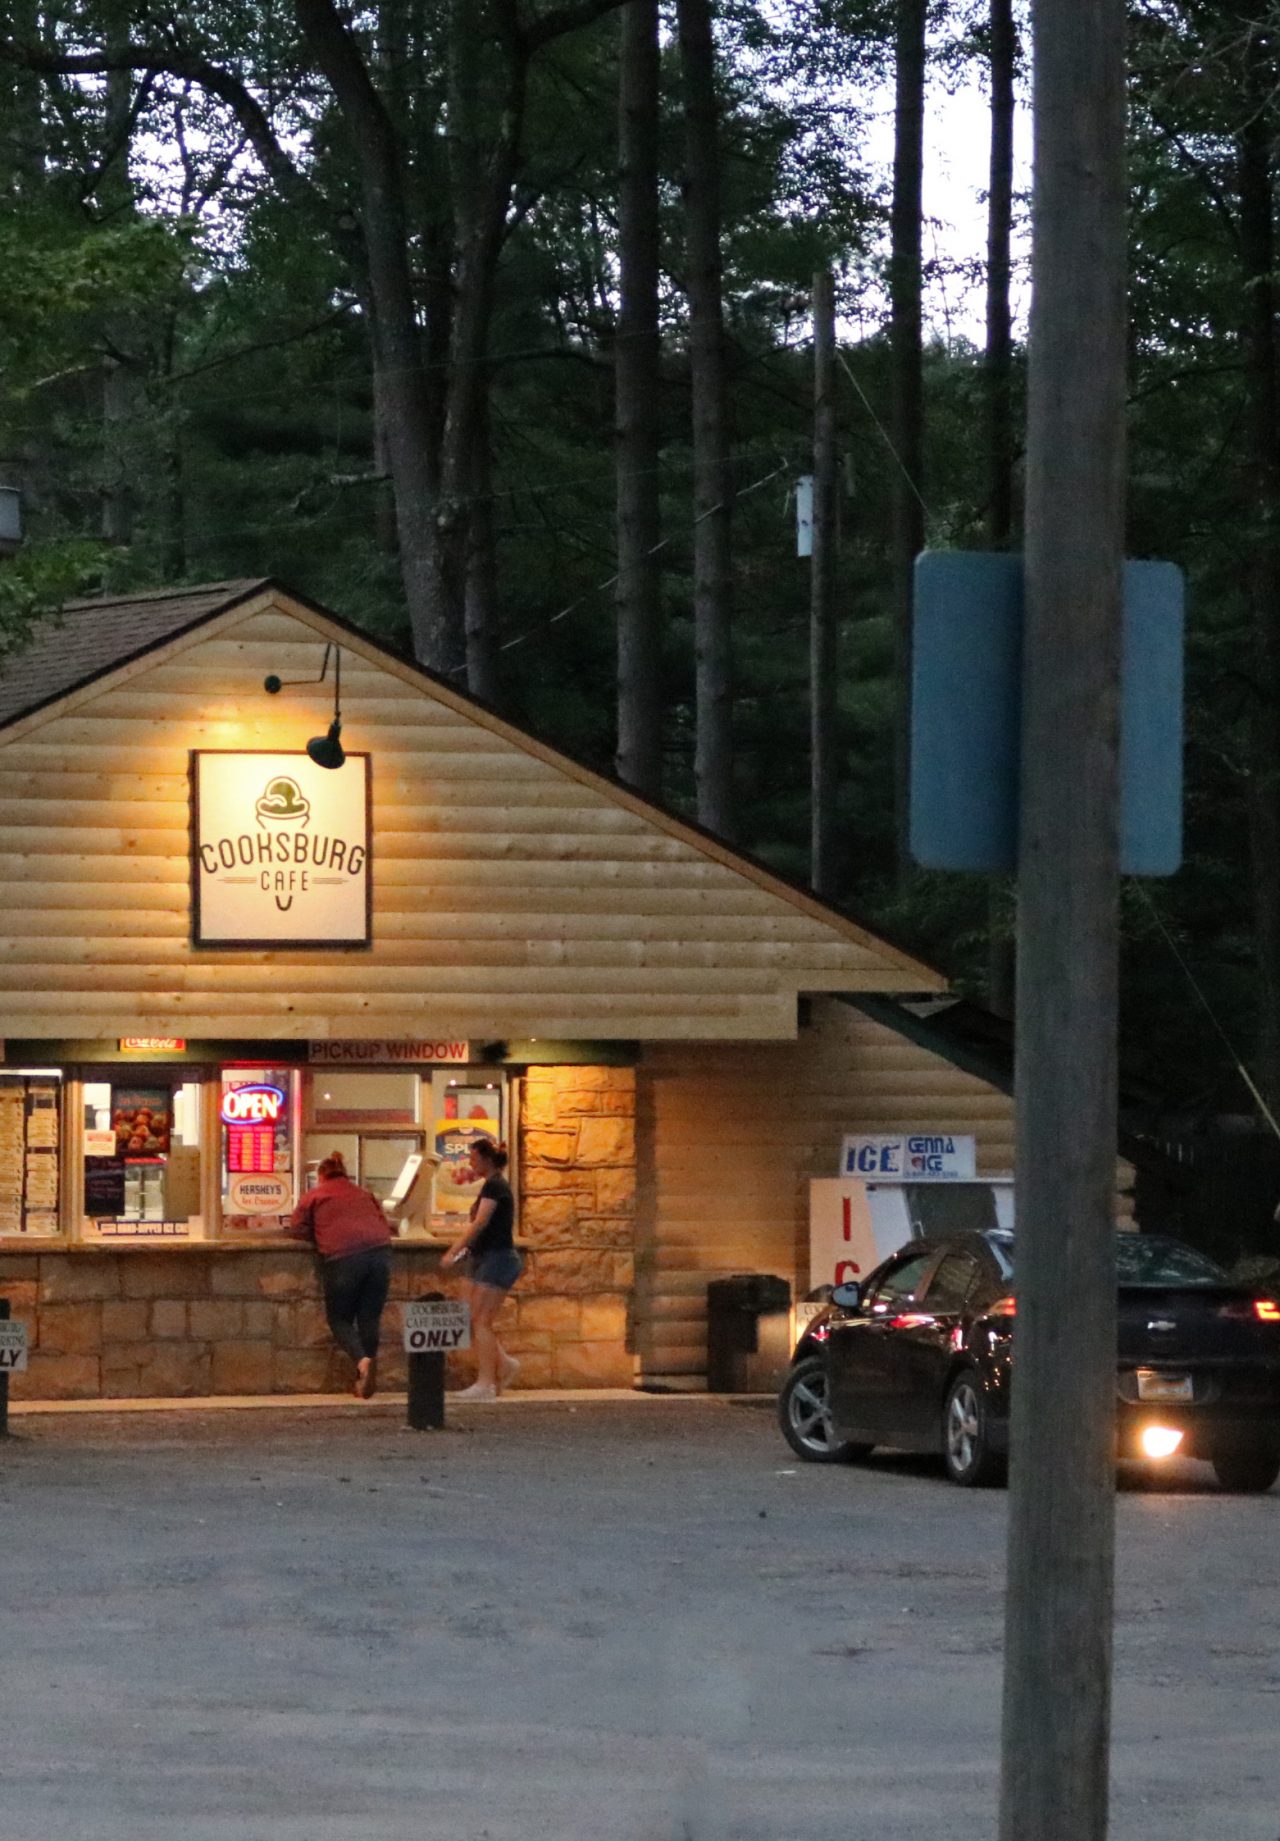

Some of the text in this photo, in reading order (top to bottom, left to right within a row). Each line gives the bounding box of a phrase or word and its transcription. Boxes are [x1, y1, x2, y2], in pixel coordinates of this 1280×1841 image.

[200, 832, 365, 875] COOKSBURG
[261, 870, 309, 891] CAFE
[312, 1041, 465, 1059] PICKUP WINDOW
[223, 1092, 277, 1118] OPEN
[445, 1143, 471, 1154] SPL
[846, 1144, 900, 1172] ICE
[922, 1155, 943, 1171] ICE
[240, 1184, 282, 1195] HERSHEY'S
[410, 1329, 464, 1349] ONLY
